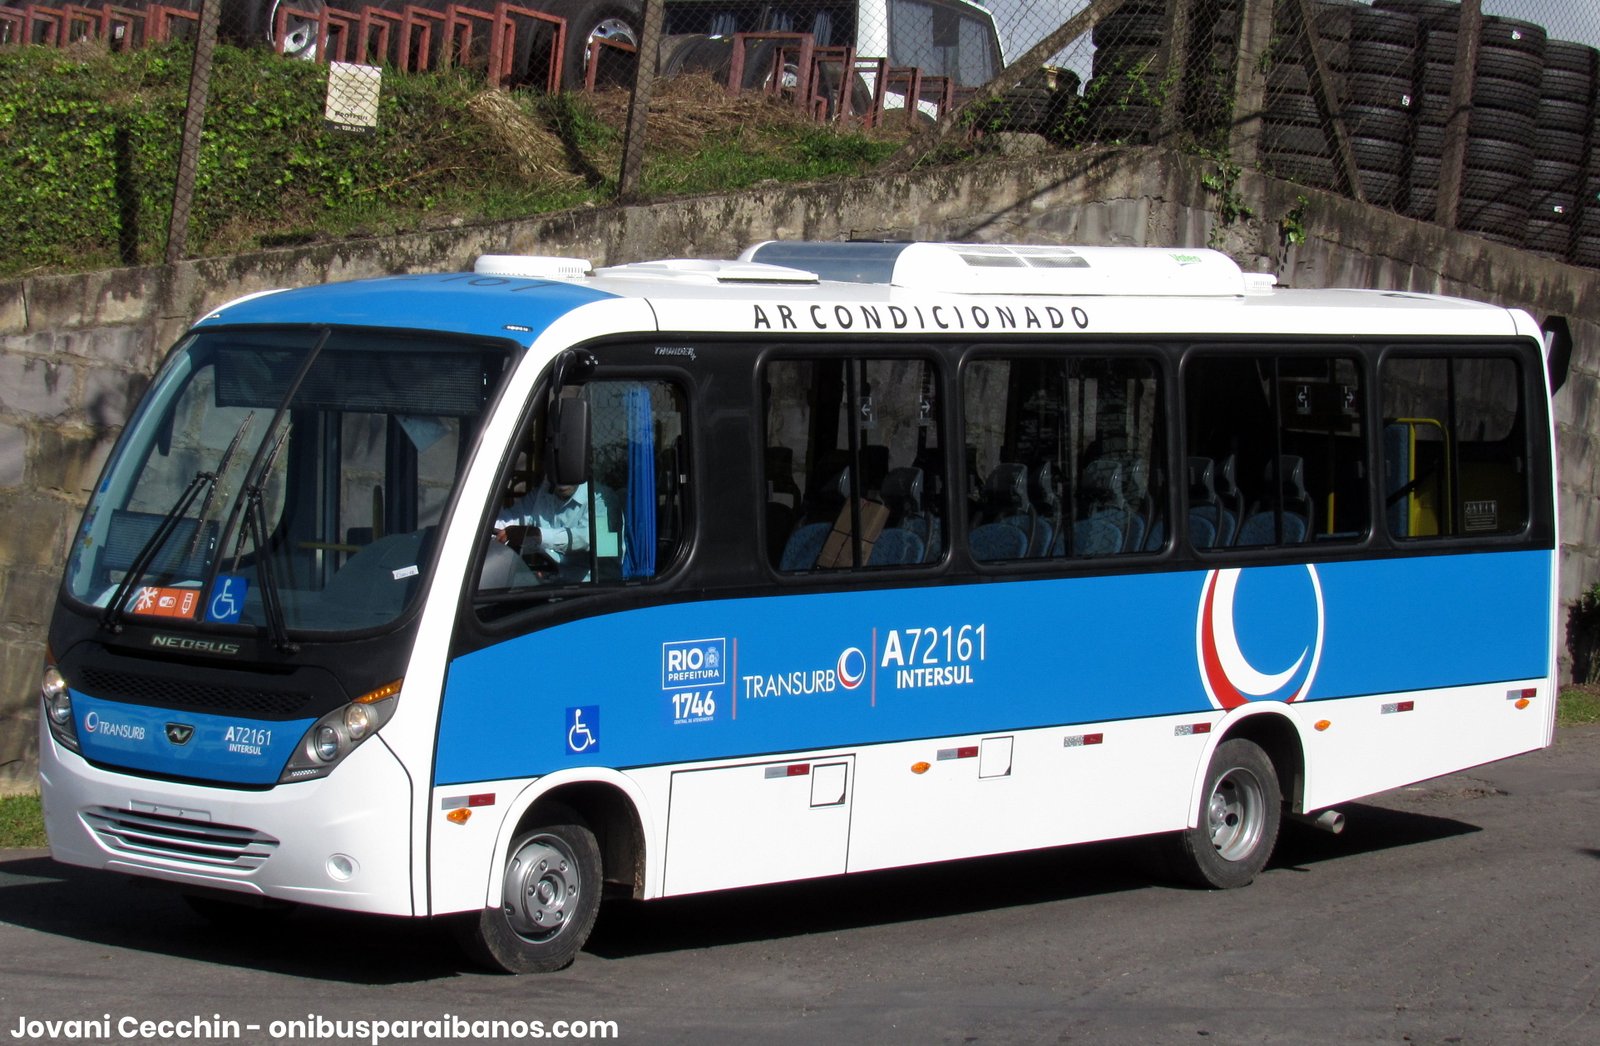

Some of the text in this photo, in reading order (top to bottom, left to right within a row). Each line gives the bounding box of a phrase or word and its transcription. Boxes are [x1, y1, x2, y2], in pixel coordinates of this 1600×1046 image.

[754, 304, 1089, 330] AR CONDICIONADO
[152, 635, 240, 655] NEOBUS
[881, 623, 987, 668] A72161
[668, 647, 704, 672] RIO
[668, 668, 720, 682] PREFEITURA
[742, 669, 836, 699] TRANSURB
[896, 665, 974, 689] INTERSUL
[672, 690, 716, 719] 1746
[99, 721, 146, 741] TRANSURB
[225, 726, 272, 746] A72161
[229, 743, 262, 755] INTERSUL
